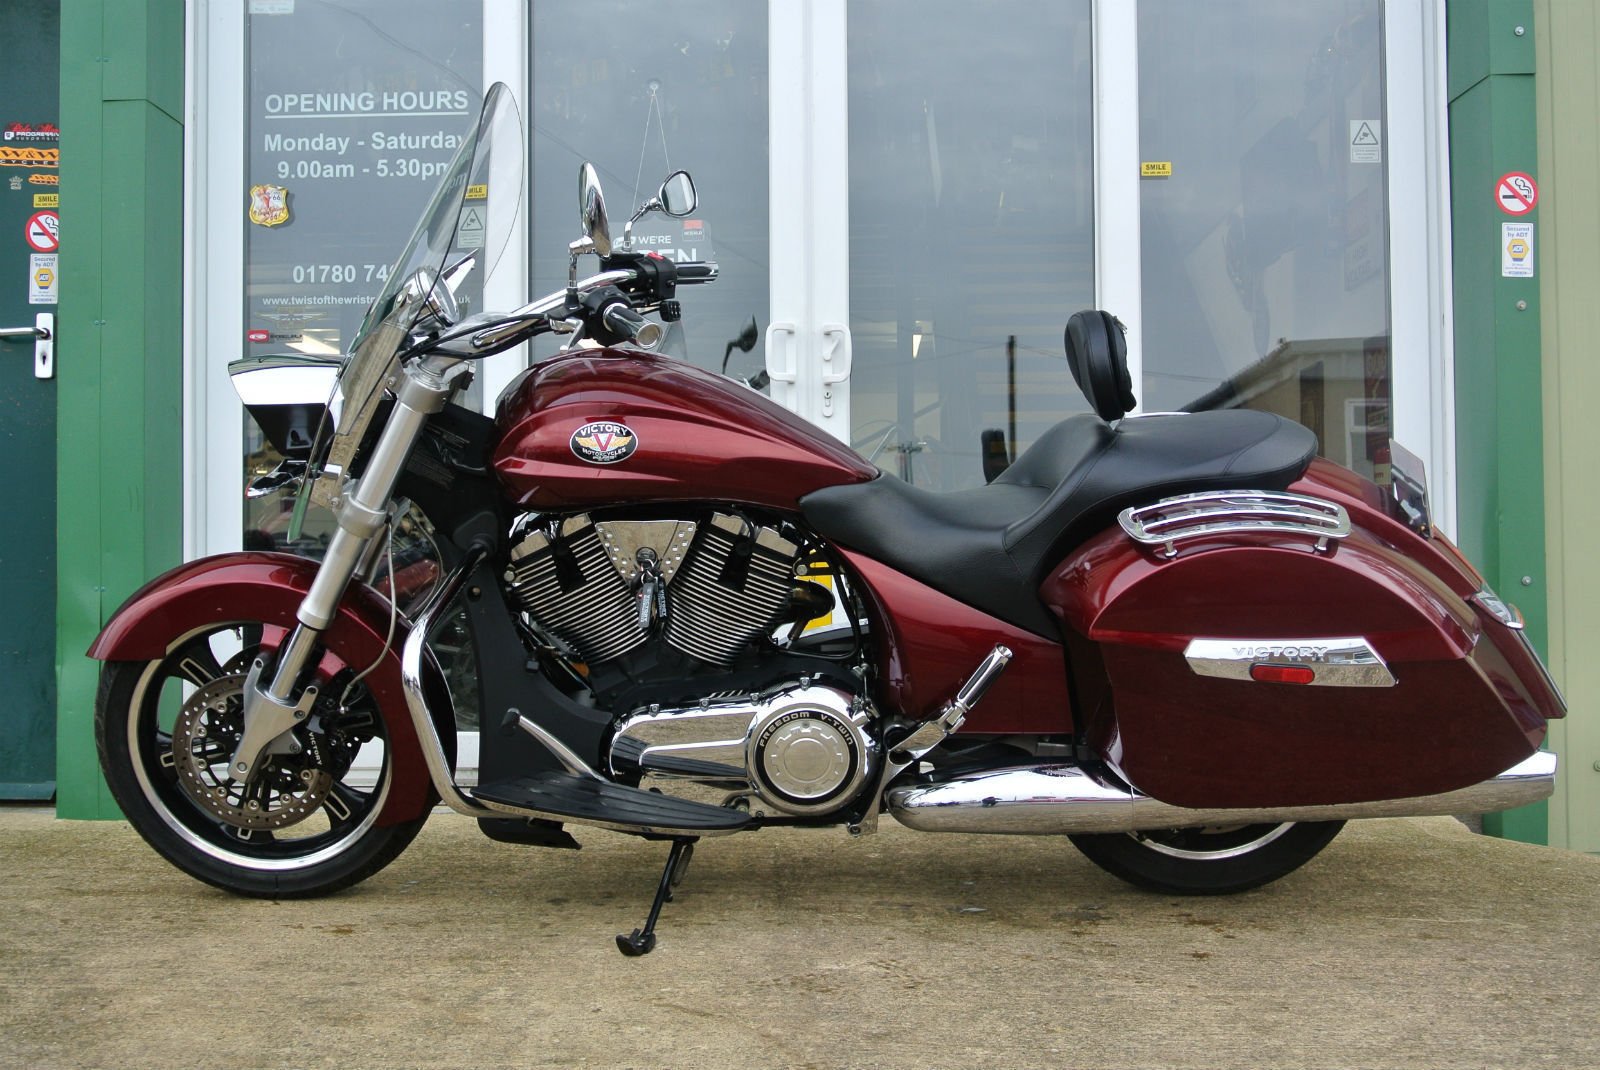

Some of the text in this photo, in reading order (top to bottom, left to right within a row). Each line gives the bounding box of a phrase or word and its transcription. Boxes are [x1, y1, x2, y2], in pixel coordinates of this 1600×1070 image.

[265, 90, 469, 113] OPENING HOURS
[264, 133, 351, 155] Monday
[277, 160, 355, 179] 9.00am
[638, 236, 672, 244] WE'RE
[292, 264, 394, 283] 01780 74
[580, 424, 628, 436] VICTORY
[582, 446, 626, 457] MOTORCYCLES
[1232, 646, 1328, 657] VICTORY
[760, 711, 853, 747] FREEDOM V-TWIN
[309, 732, 323, 765] VICTORY
